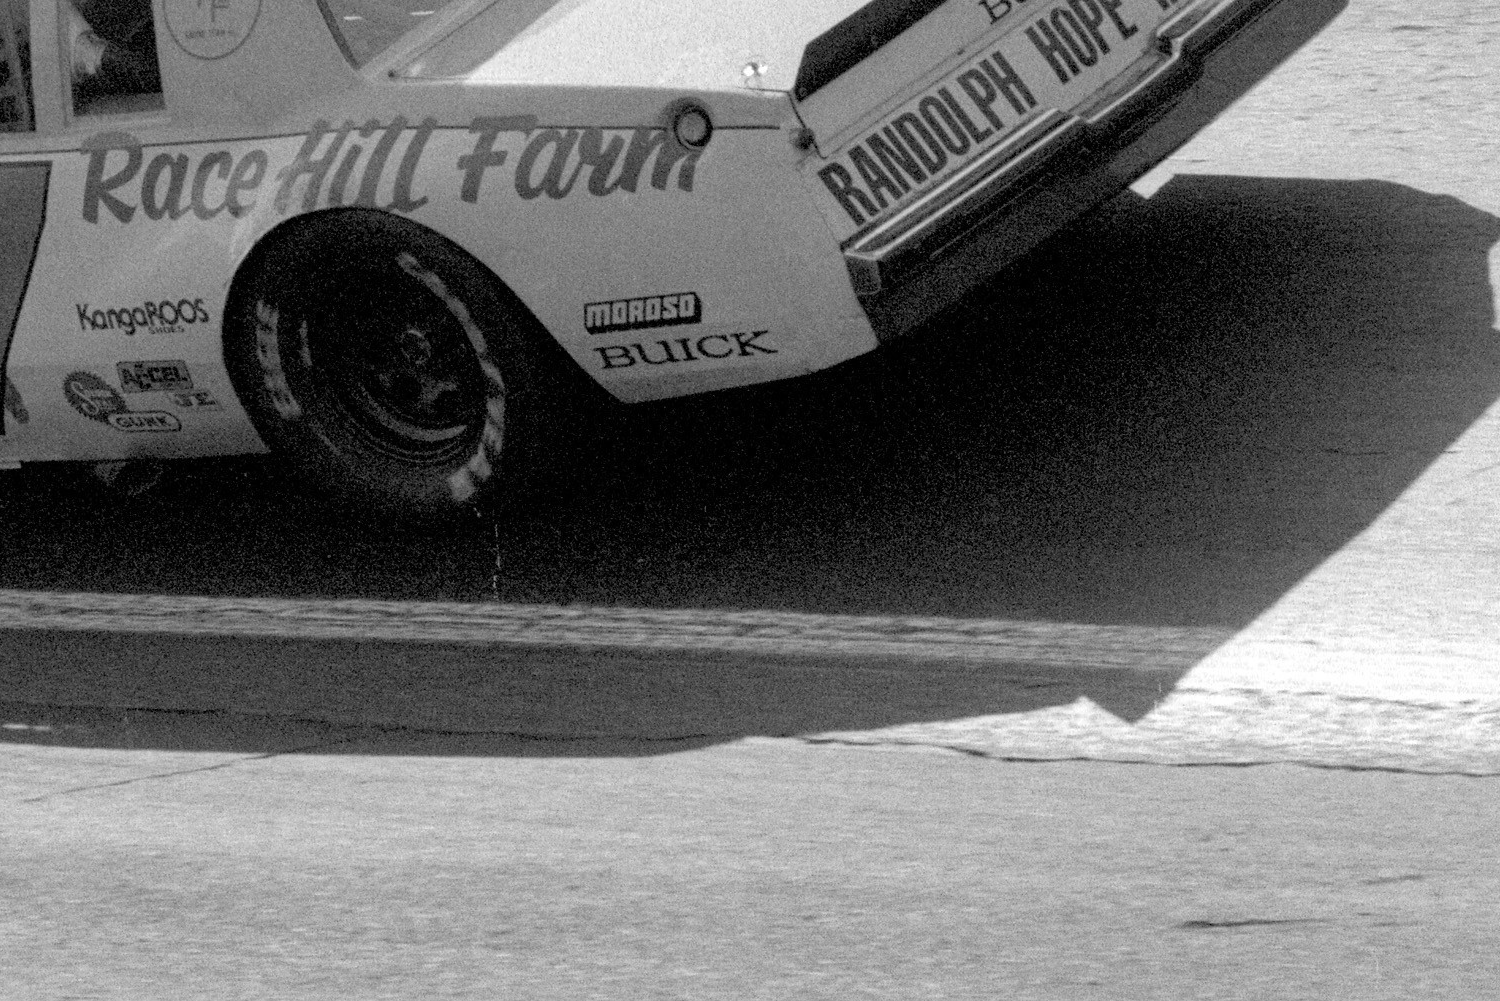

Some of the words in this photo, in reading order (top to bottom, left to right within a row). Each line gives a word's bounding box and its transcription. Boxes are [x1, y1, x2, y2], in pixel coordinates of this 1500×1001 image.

[817, 51, 1038, 227] RANDOLPH
[81, 130, 268, 224] Race
[276, 116, 438, 214] Hill
[457, 114, 705, 203] Farm
[76, 298, 209, 335] KangaROOS
[586, 293, 696, 329] MOROSO
[593, 330, 779, 370] BUICK
